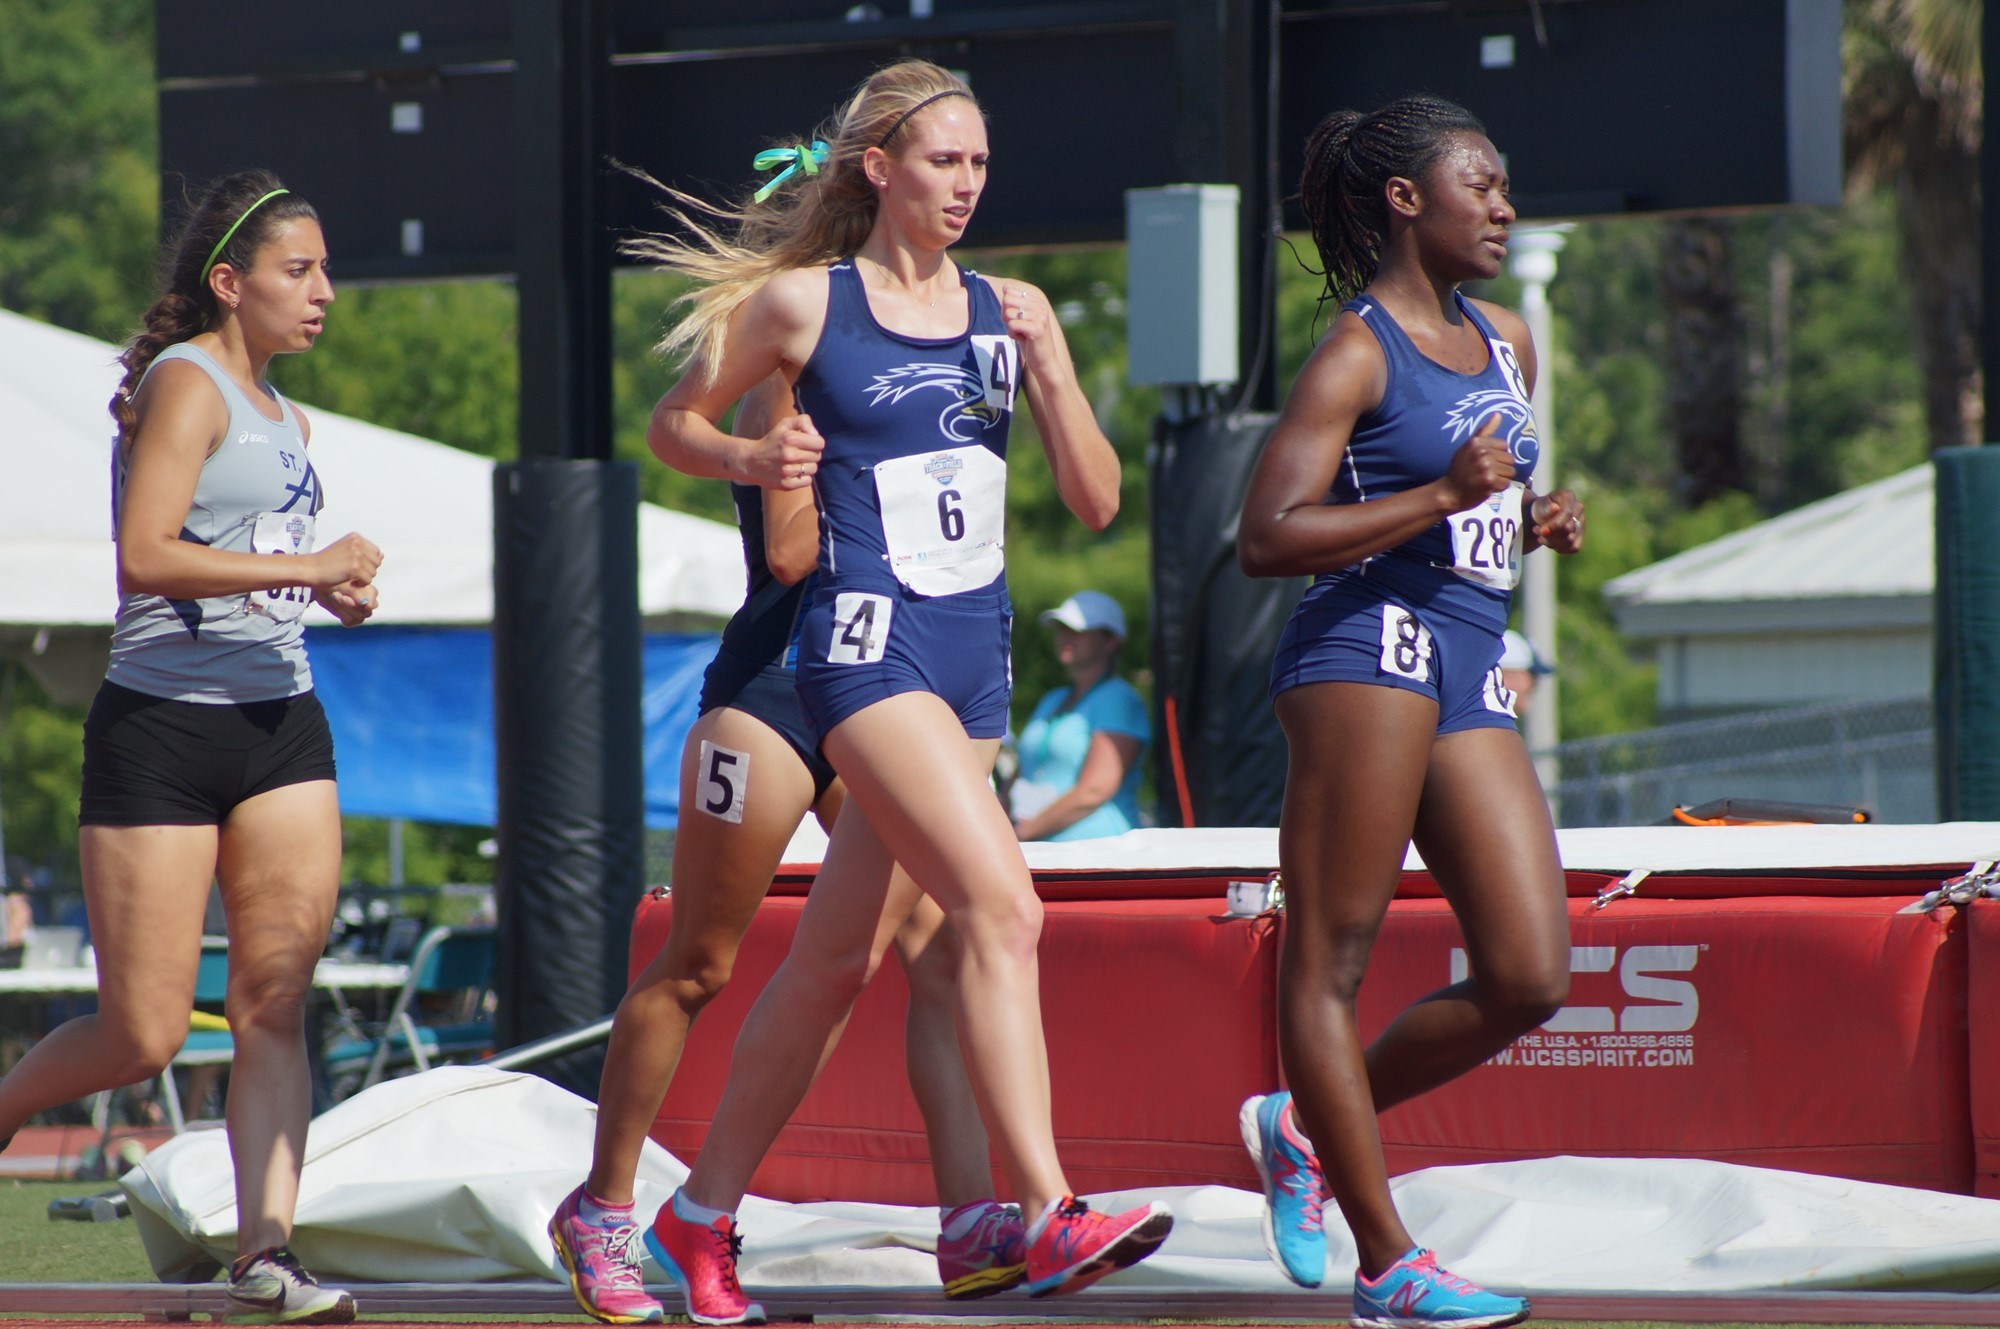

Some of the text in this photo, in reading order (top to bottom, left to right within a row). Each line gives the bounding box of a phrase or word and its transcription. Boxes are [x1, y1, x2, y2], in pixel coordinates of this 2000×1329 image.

[990, 341, 1011, 406] 4
[1499, 345, 1530, 405] 8
[280, 450, 301, 473] ST.
[937, 489, 965, 542] 6
[1461, 517, 1517, 570] 282
[840, 599, 876, 661] 4
[1394, 614, 1419, 673] 8
[706, 749, 737, 815] 5
[1450, 945, 1699, 1032] CS
